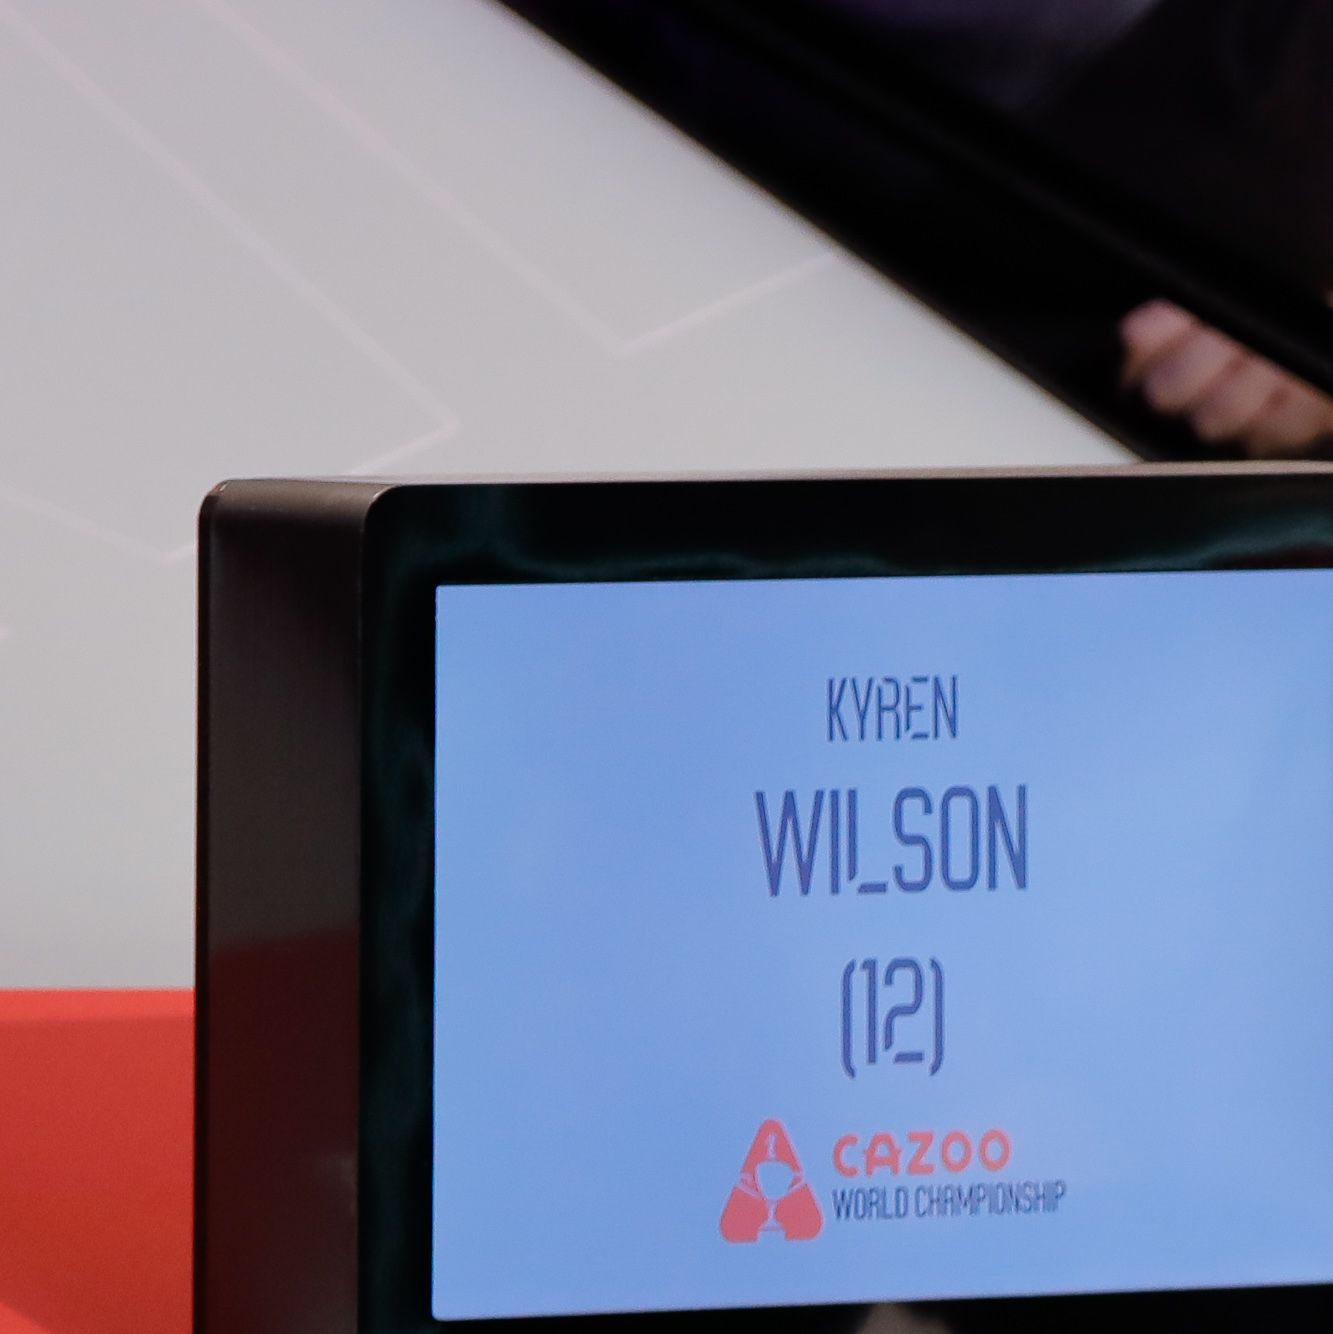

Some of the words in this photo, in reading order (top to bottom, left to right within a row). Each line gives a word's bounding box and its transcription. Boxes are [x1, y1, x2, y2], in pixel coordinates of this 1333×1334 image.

[827, 675, 958, 742] KYREN
[755, 785, 1027, 897] WILSON
[842, 957, 944, 1078] (12)
[833, 1129, 1011, 1177] CAZOO
[831, 1187, 909, 1221] WORLD
[915, 1179, 1066, 1218] CHAMPIONSHIP
